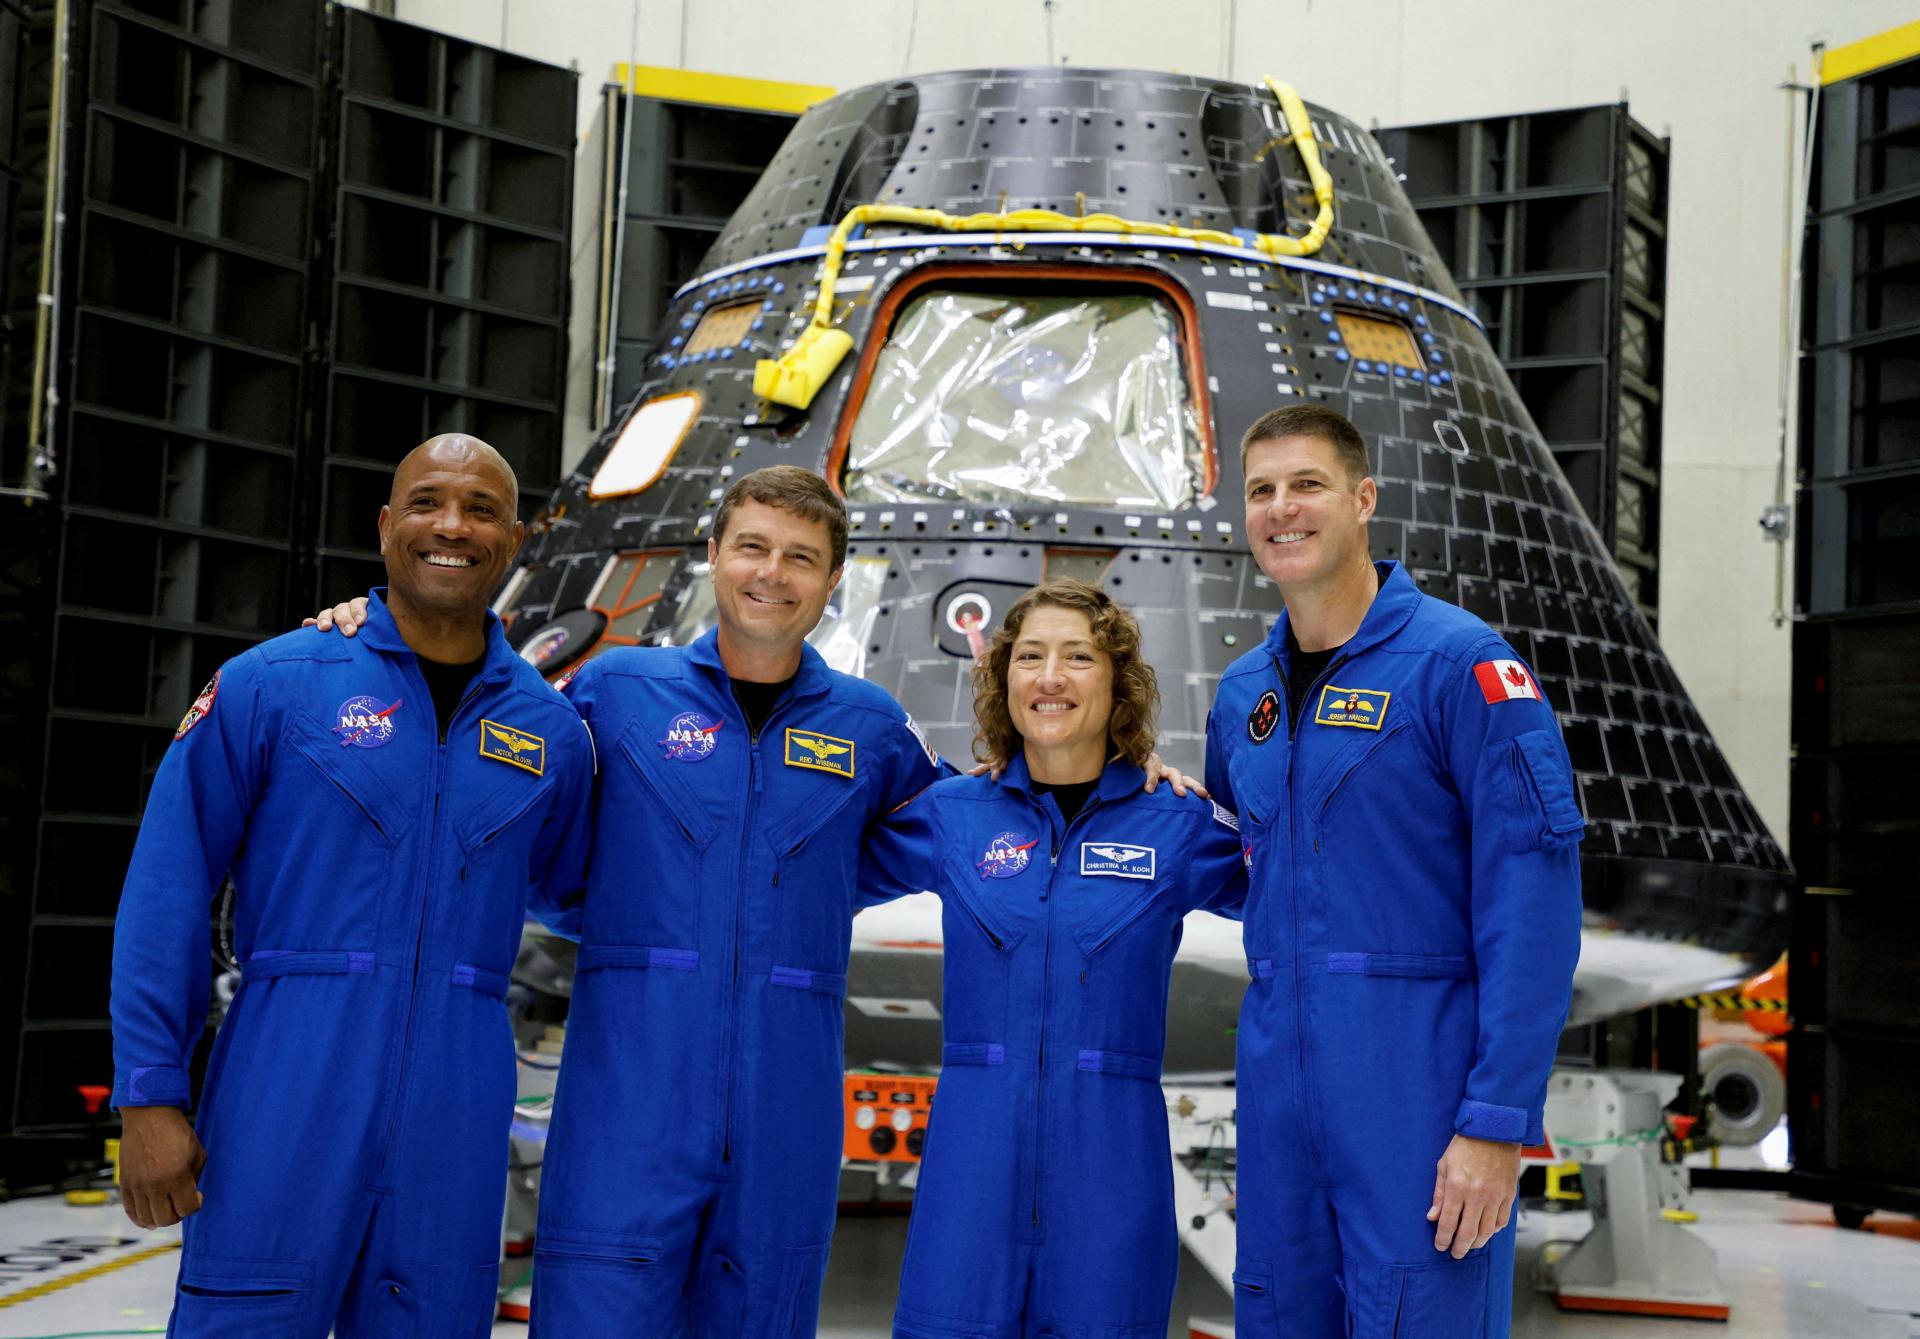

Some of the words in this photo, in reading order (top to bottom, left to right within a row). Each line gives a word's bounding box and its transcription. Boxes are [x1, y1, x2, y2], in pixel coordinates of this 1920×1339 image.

[341, 715, 393, 729] NASA
[1328, 713, 1348, 721] JEREMY
[668, 730, 715, 744] NASA
[495, 747, 513, 758] VICTOR
[800, 756, 812, 765] REID
[816, 759, 842, 770] WISEMAN
[985, 848, 1028, 862] NASA
[1086, 862, 1119, 871] CHRISTINA
[1132, 865, 1151, 874] KOCH
